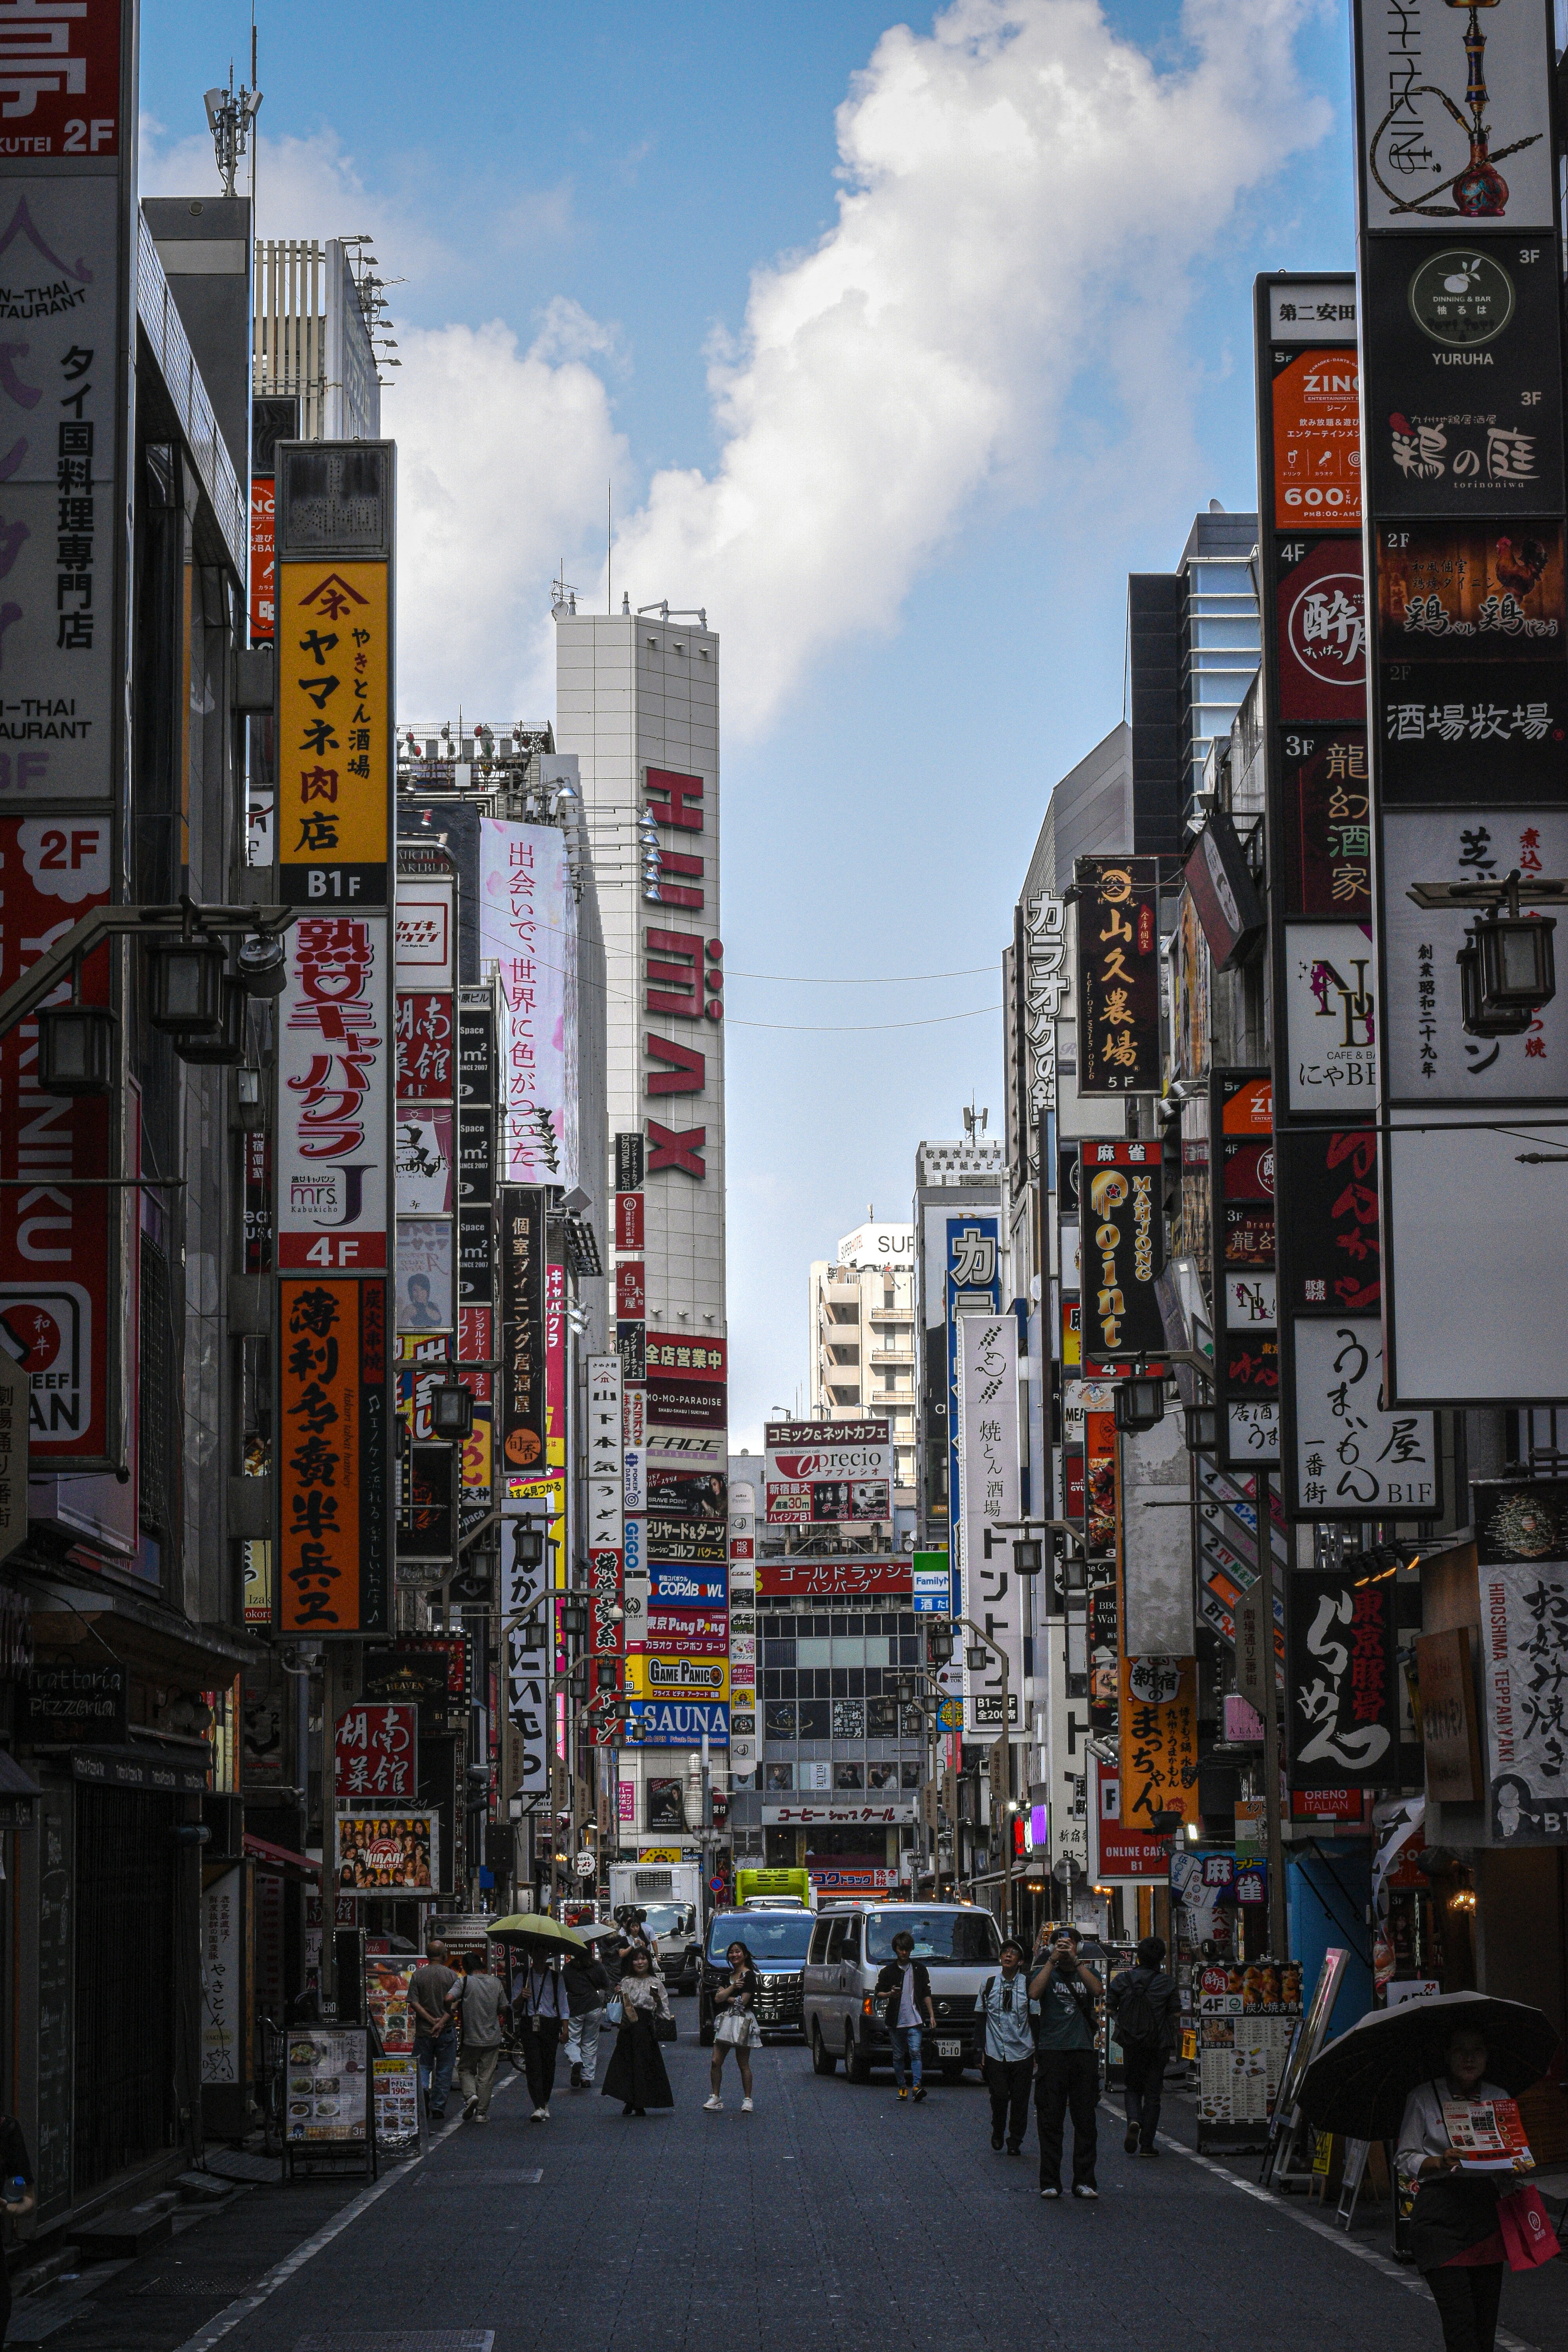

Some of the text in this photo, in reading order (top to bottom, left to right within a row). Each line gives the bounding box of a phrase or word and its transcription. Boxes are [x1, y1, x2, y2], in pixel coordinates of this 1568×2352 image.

[64, 120, 114, 151] 2F
[1519, 250, 1540, 264] 3F
[1279, 304, 1356, 321] 第二安田
[1275, 352, 1292, 363] 5F
[1432, 353, 1494, 365] YURUHA
[1521, 392, 1541, 405] 3F
[1411, 414, 1497, 425] 九州地鶏居酒屋
[1391, 422, 1540, 480] 鶏の庭
[57, 344, 94, 650] タイ国料理専門店
[1285, 488, 1343, 506] 600
[1388, 533, 1410, 547] 2F
[1281, 544, 1305, 563] 4F
[1302, 645, 1344, 661] すいげつ
[347, 628, 371, 779] やきとん酒場
[1387, 703, 1553, 741] 酒場牧場
[294, 630, 340, 852] ヤマネ肉店
[1286, 736, 1314, 756] 3F
[1326, 742, 1372, 901] 龍幻酒家
[39, 831, 99, 869] 2F
[308, 870, 360, 897] B1F
[1100, 909, 1138, 1067] 山久農場
[506, 842, 537, 1167] 出会いで、世界に色がついた
[1419, 944, 1437, 1079] 創業昭和二十九年
[460, 1026, 484, 1035] Space
[403, 1084, 428, 1096] 4F
[1224, 1082, 1240, 1091] 5F
[461, 1124, 484, 1132] Space
[1097, 1144, 1146, 1162] 麻雀
[1225, 1145, 1238, 1153] 4F
[410, 1200, 419, 1209] 3F
[1228, 1211, 1243, 1221] 3F
[461, 1223, 485, 1232] Space
[1132, 1176, 1152, 1281] MAHJONG
[306, 1237, 359, 1266] 4F
[512, 1217, 531, 1413] 個室ダイニング居酒屋
[548, 1270, 562, 1347] キャバクラ
[32, 1314, 50, 1356] 和牛
[646, 1343, 722, 1370] 全店営業中
[634, 1401, 643, 1438] カラオケ
[769, 1426, 886, 1442] コミック&ネットカフェ
[980, 1420, 1004, 1517] 焼とん酒場
[1303, 1440, 1327, 1504] 一番街
[1204, 1473, 1218, 1484] 4
[769, 1483, 811, 1495] 新宿最大
[1388, 1483, 1432, 1503] B1F
[776, 1497, 809, 1510] 直進30m
[769, 1512, 811, 1521] ハイジアB1
[669, 1544, 695, 1557] ゴルフ
[1204, 1538, 1219, 1552] 2
[807, 1580, 871, 1592] ハンバーグ
[669, 1618, 695, 1635] Ping
[646, 1641, 671, 1650] カラオケ
[707, 1642, 726, 1651] ダーツ
[1244, 1609, 1256, 1686] 劇場通り一番街
[651, 1661, 678, 1683] GAME
[1489, 1583, 1514, 1762] HIROSHIMA TEPPANYAKI
[644, 1705, 728, 1732] SAUNA
[1132, 1706, 1165, 1817] まっちゃん
[1305, 1789, 1348, 1800] ORENO
[713, 1805, 726, 1813] 受付
[1304, 1801, 1348, 1811] ITALIAN
[778, 1808, 895, 1822] コーヒー クール
[1106, 1846, 1139, 1856] ONLINE
[1131, 1861, 1142, 1871] B1
[876, 1870, 887, 1886] 免税
[210, 1964, 226, 2027] やきとん
[1203, 1998, 1223, 2011] 4F
[1246, 2002, 1298, 2013] 炭火焼き鳥
